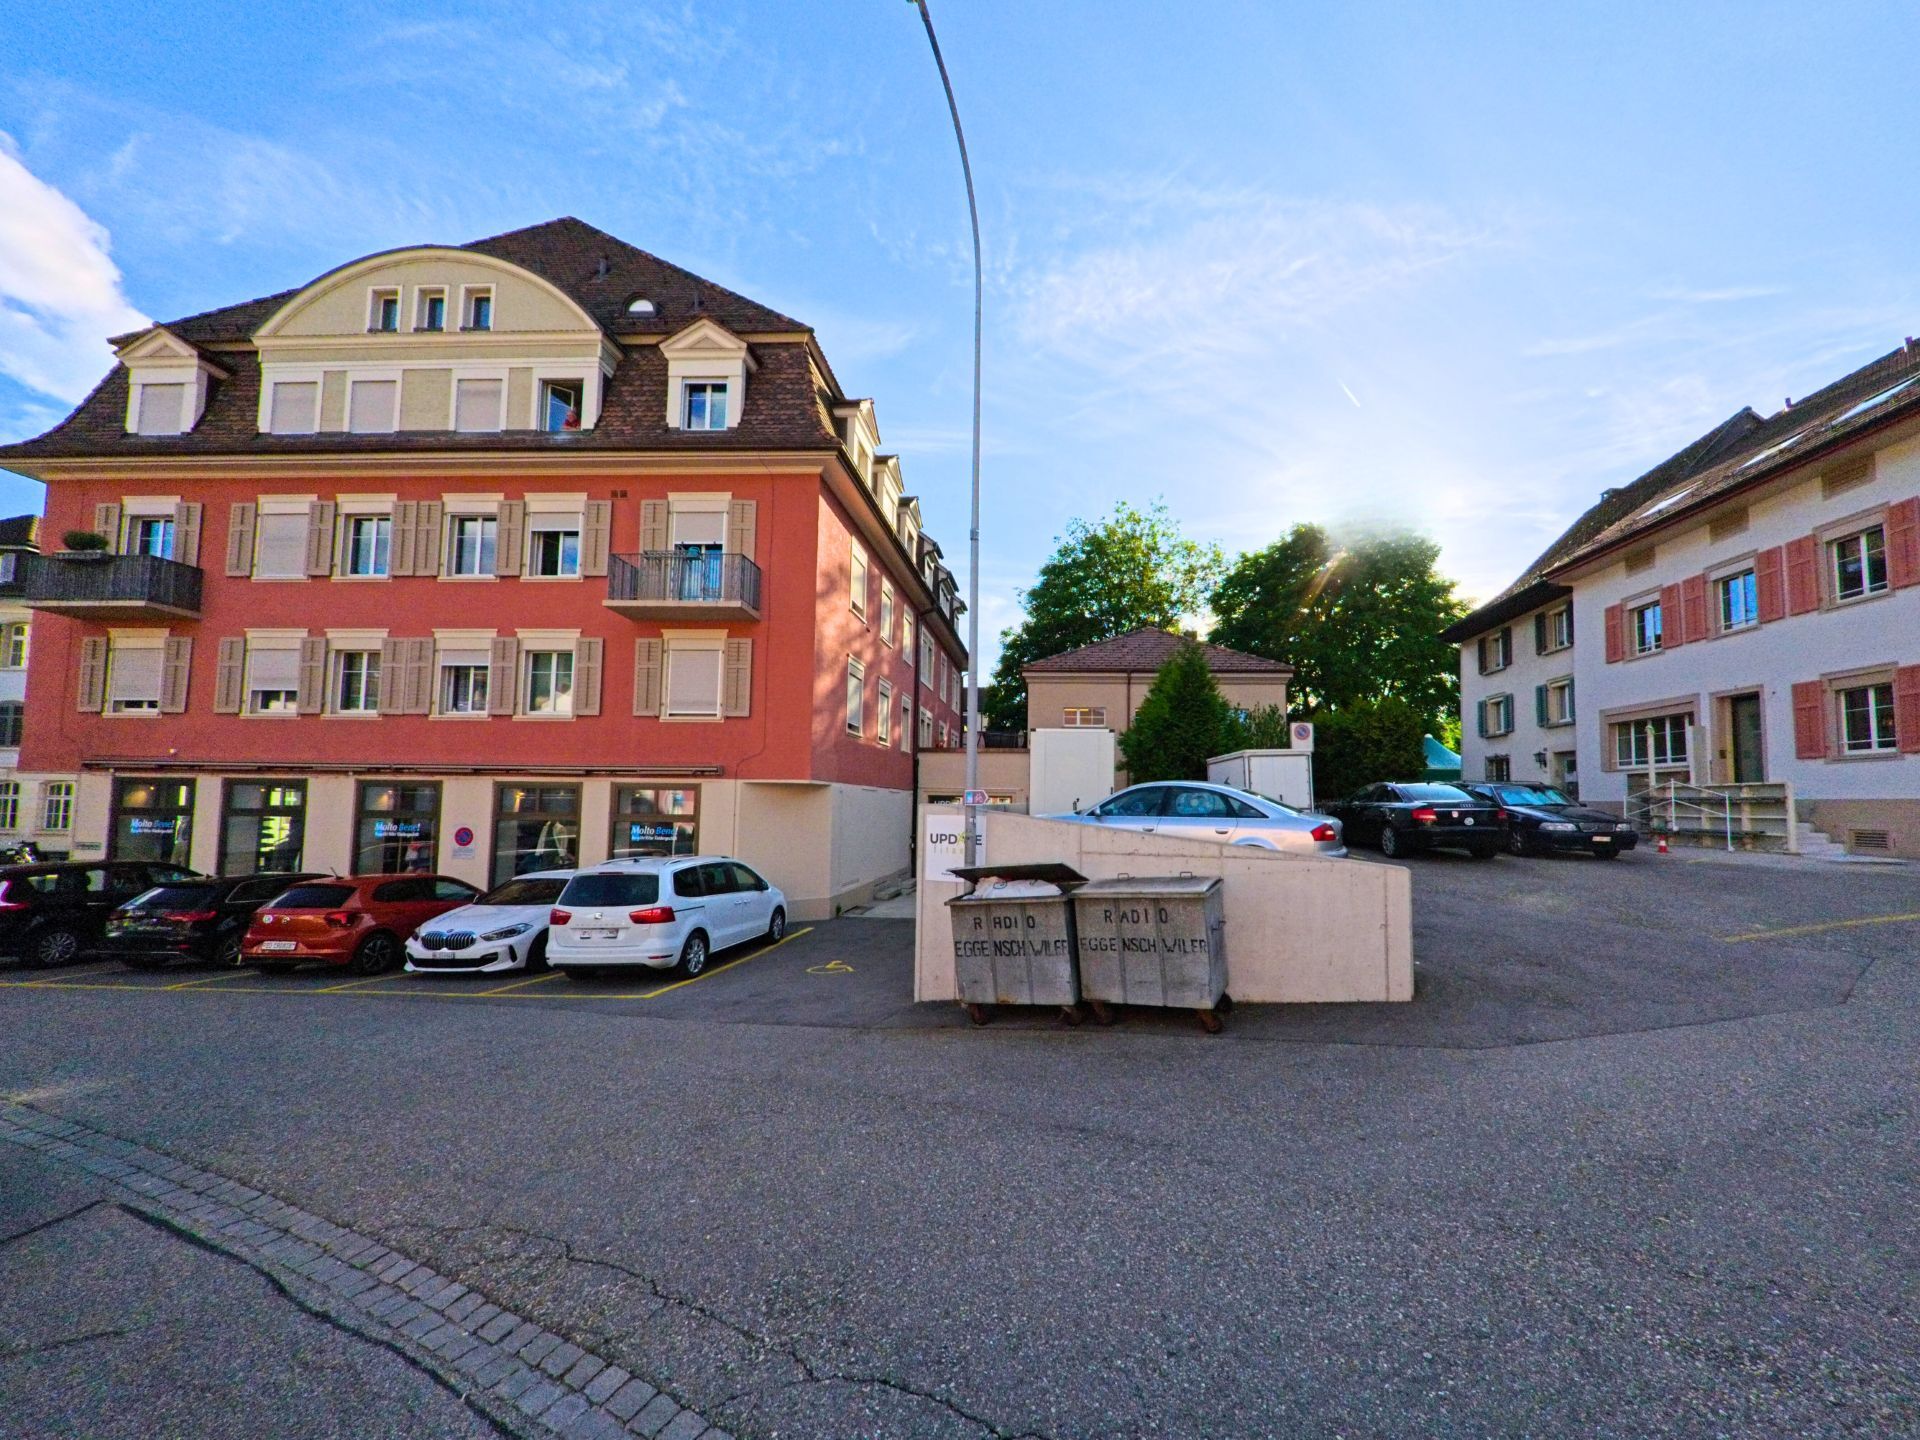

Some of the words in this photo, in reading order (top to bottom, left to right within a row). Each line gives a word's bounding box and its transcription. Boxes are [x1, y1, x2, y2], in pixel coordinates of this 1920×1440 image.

[131, 819, 153, 828] Molto
[375, 821, 398, 831] Molto
[399, 822, 421, 831] Bene!
[631, 825, 655, 835] Molto
[1104, 908, 1169, 924] RADIO
[973, 915, 1036, 930] RADIO
